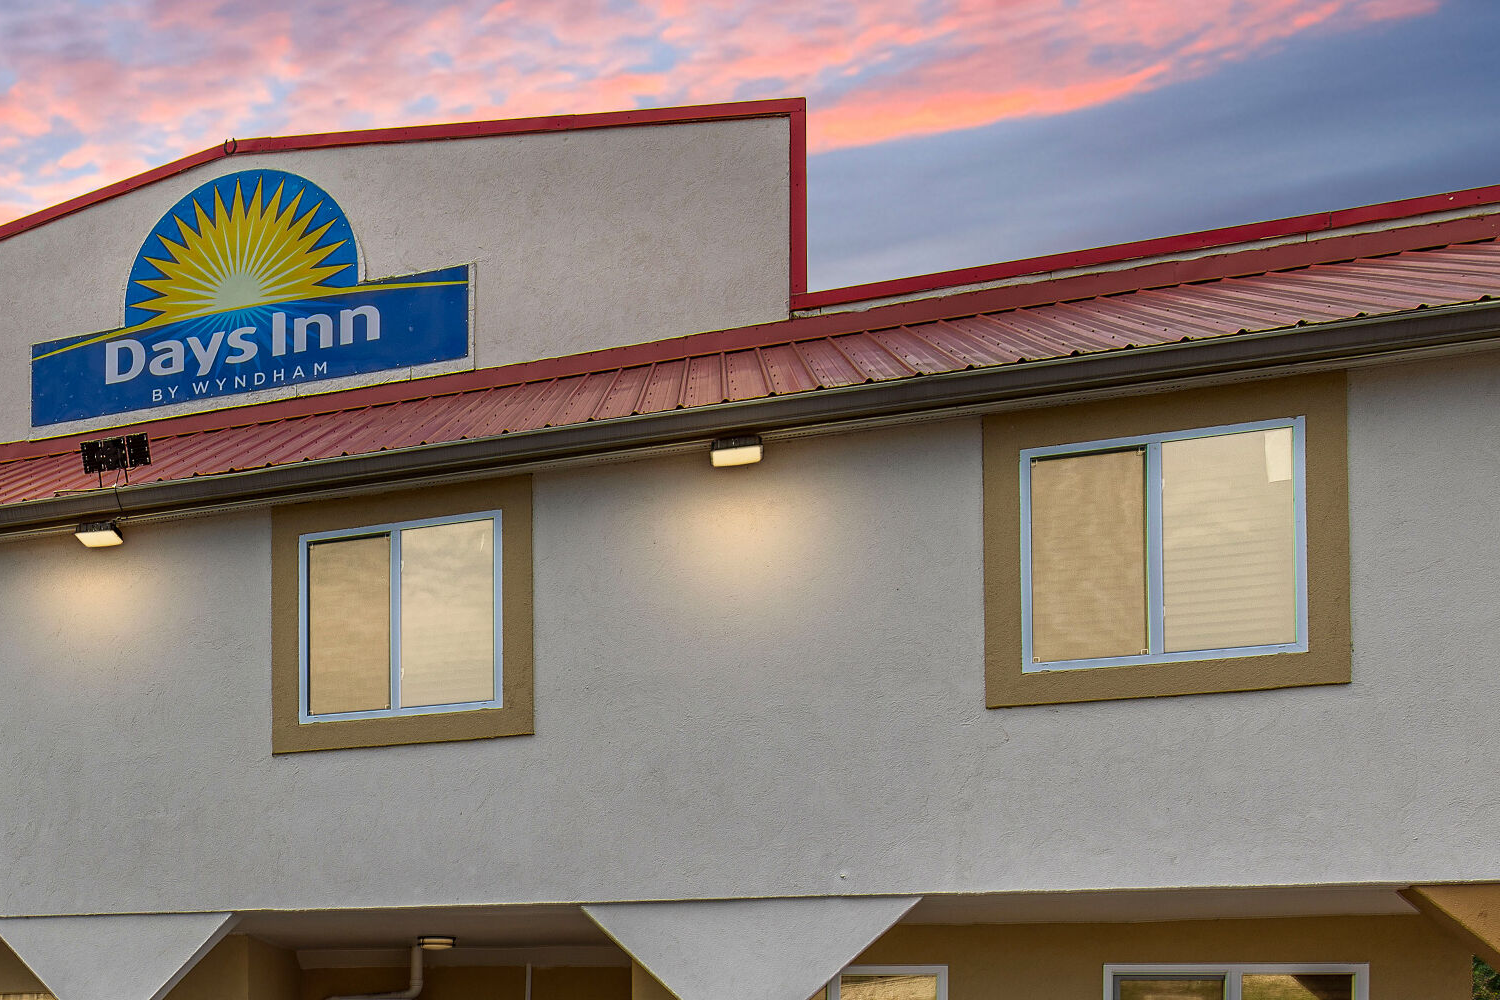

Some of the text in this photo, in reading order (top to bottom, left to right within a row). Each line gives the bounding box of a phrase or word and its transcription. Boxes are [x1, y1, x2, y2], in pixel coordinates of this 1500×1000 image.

[105, 305, 380, 385] Days Inn
[152, 361, 327, 402] BY WYNDHAM
